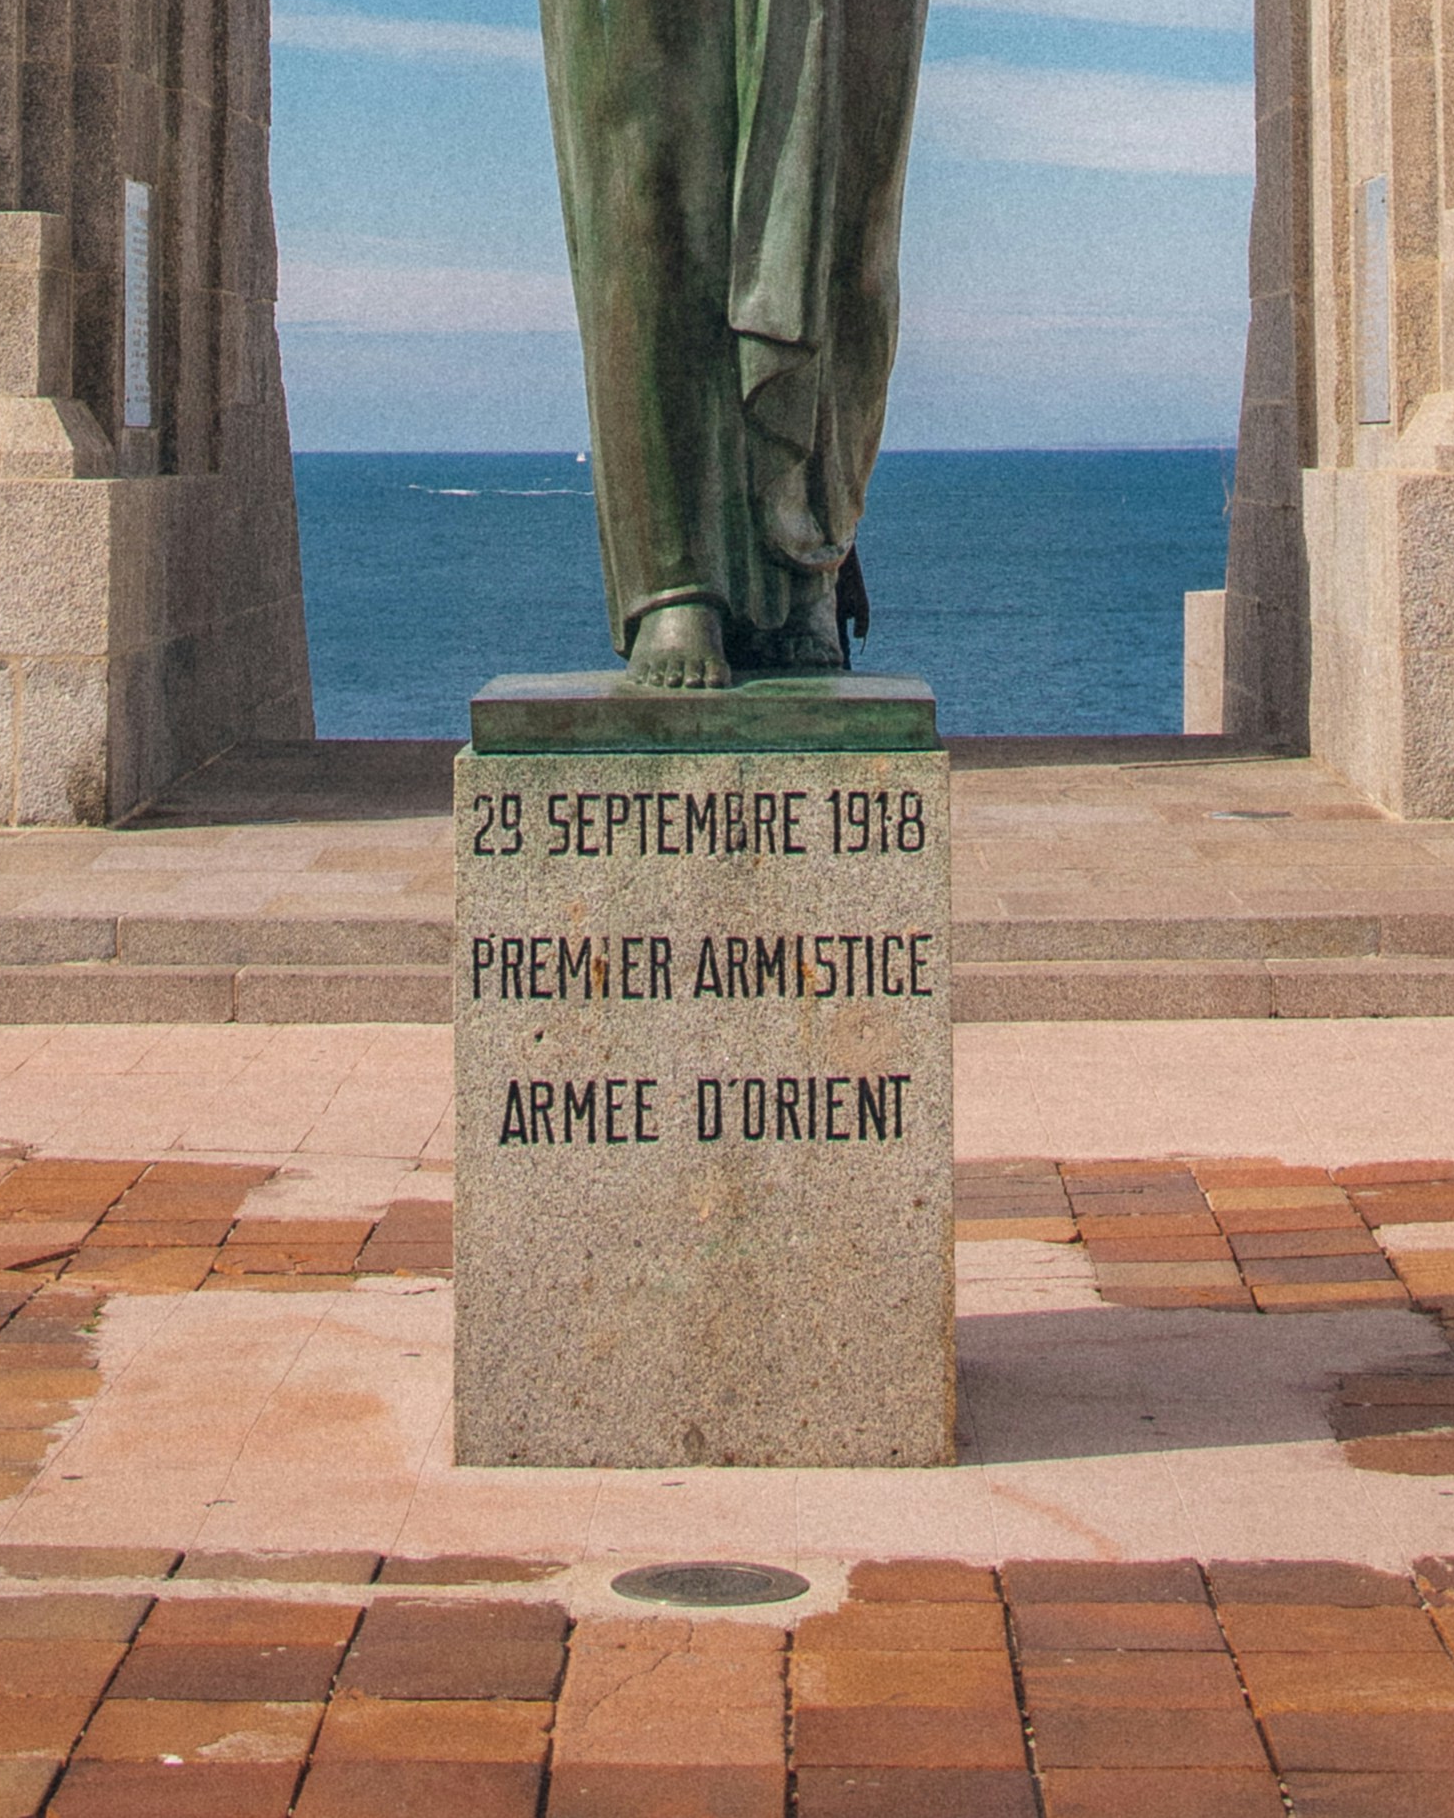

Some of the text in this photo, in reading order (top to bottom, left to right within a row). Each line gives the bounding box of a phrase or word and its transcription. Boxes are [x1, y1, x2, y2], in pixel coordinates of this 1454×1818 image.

[472, 789, 926, 857] 29 SEPTEMBRE 1918
[471, 934, 933, 1000] PREMIER ARMISTICE
[499, 1075, 911, 1145] ARMEE D'ORIENT
